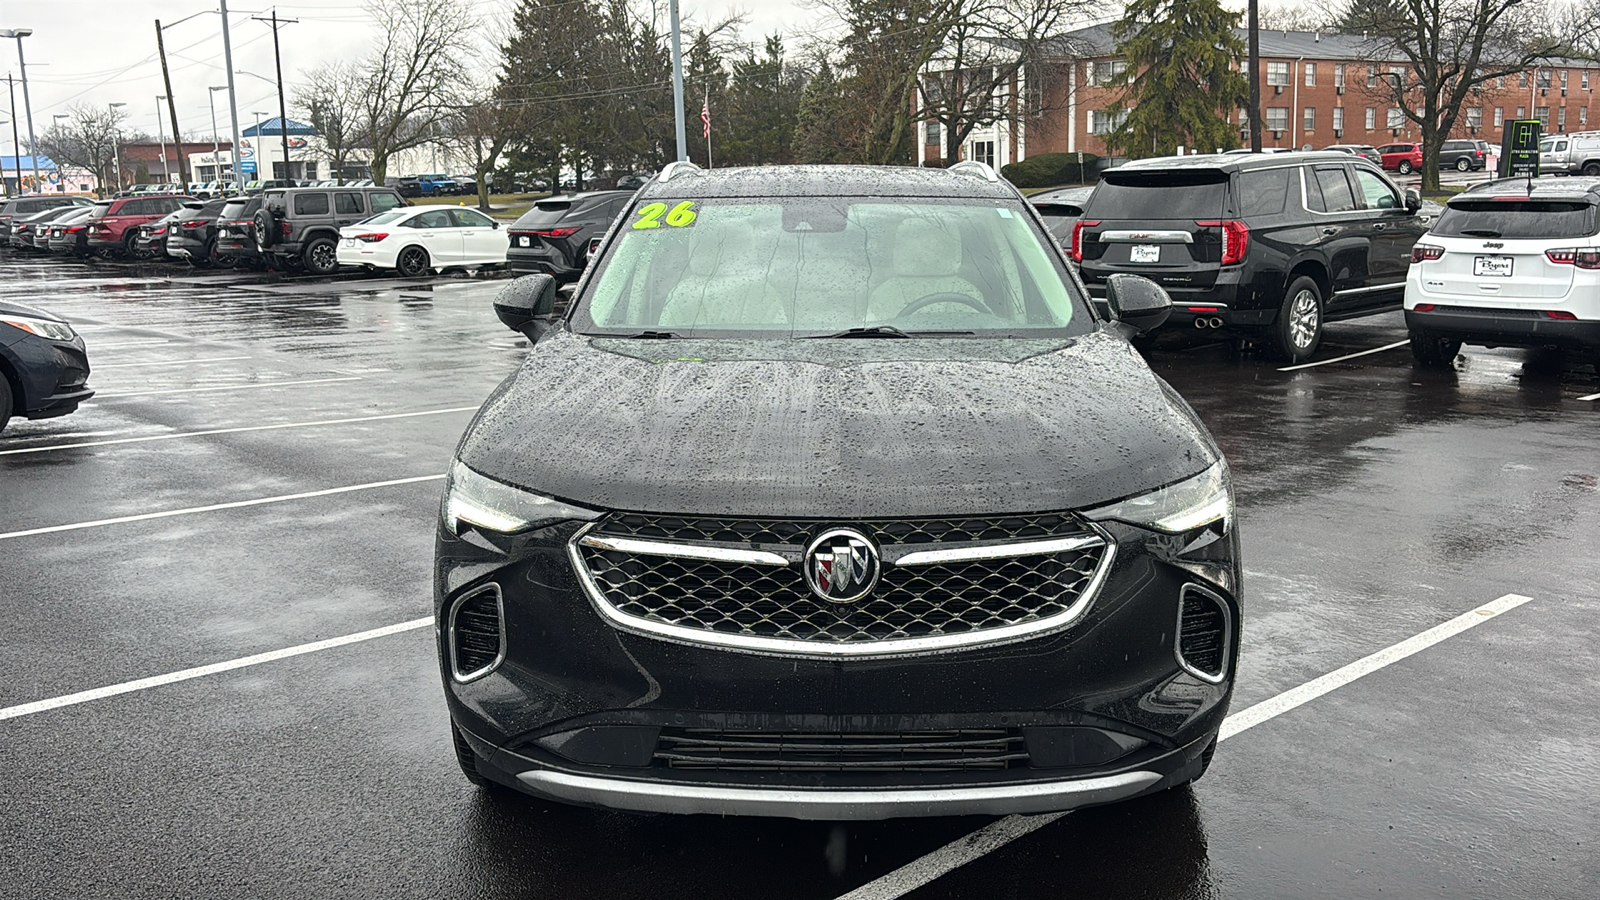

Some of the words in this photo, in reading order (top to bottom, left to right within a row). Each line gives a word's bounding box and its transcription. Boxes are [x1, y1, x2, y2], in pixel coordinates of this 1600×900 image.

[632, 200, 697, 230] 26
[1482, 241, 1504, 249] Jeep
[1479, 260, 1509, 270] Byers
